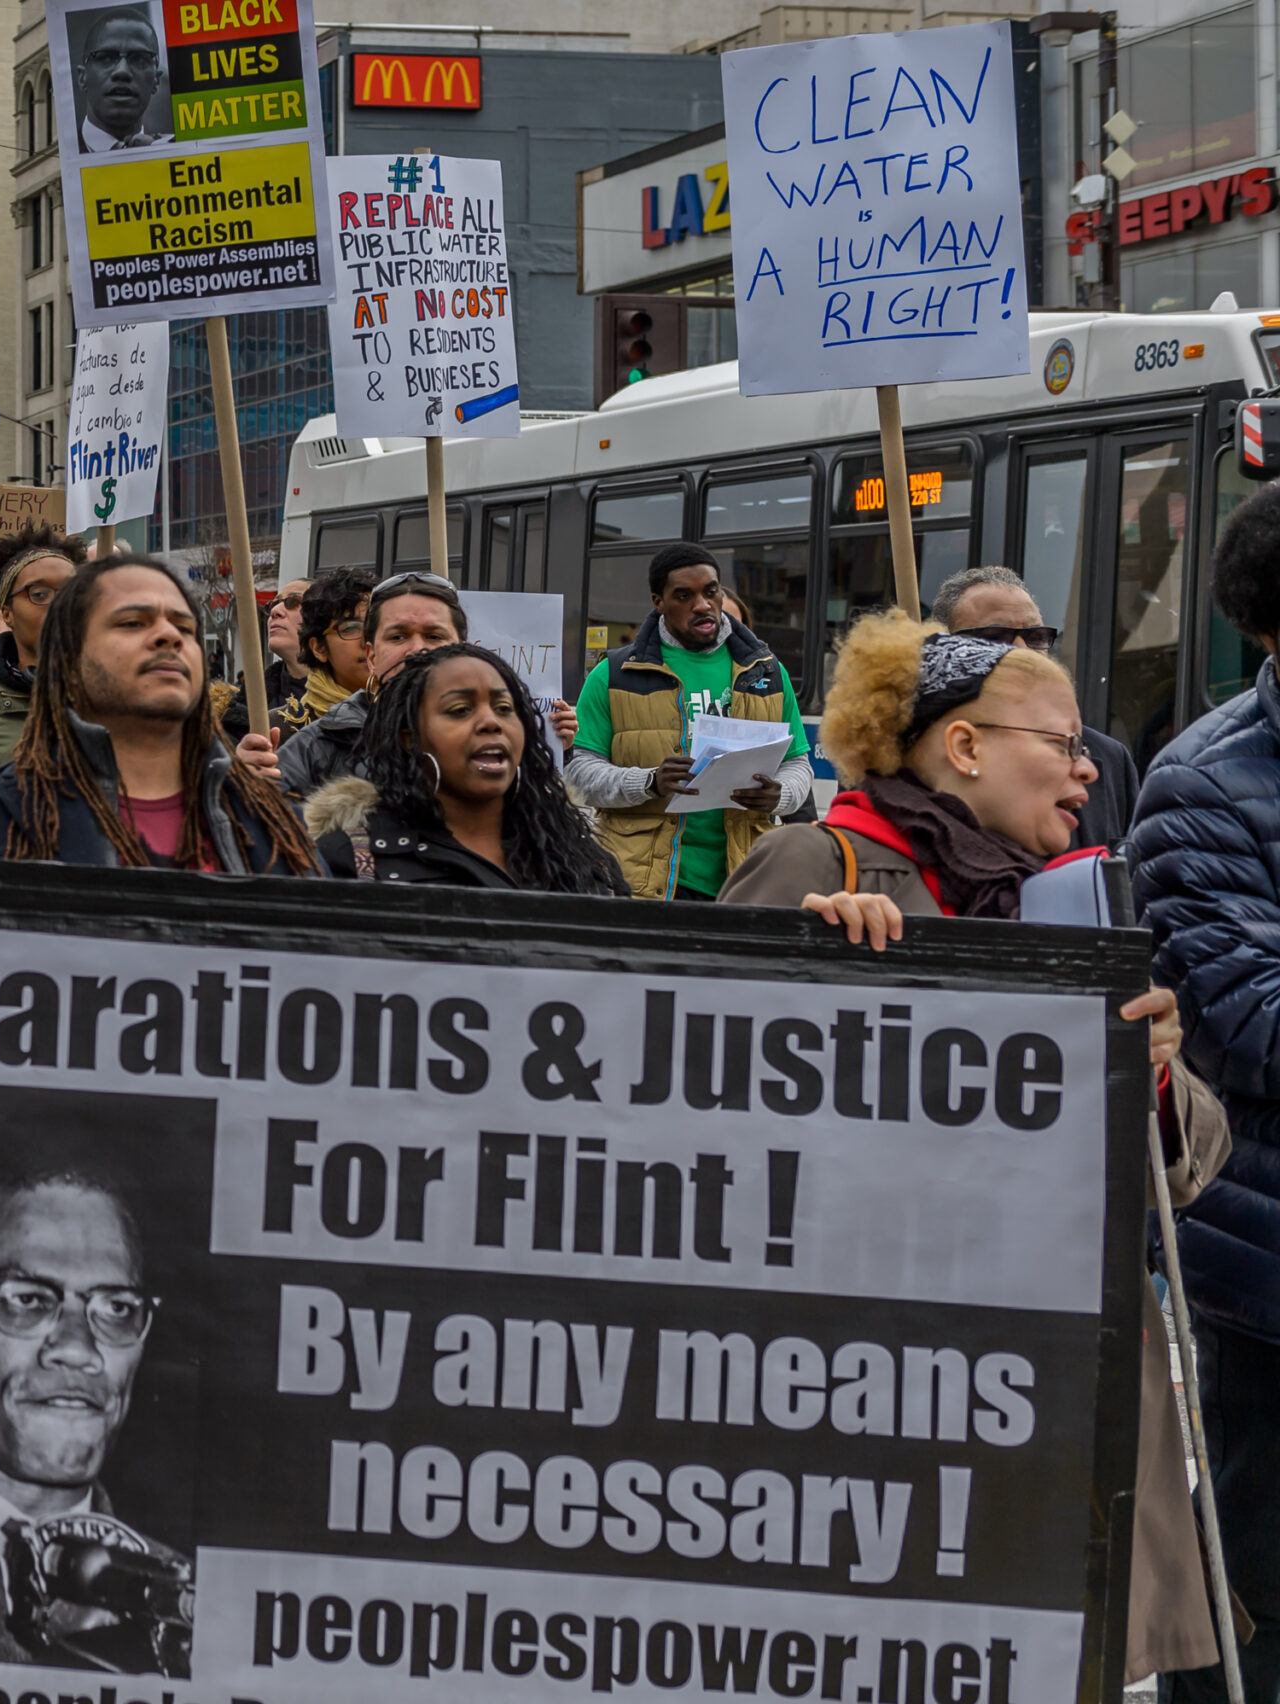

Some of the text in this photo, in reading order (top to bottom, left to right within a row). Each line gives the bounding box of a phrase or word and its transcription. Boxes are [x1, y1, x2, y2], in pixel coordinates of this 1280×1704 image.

[180, 0, 283, 34] BLACK
[191, 44, 279, 81] LIVES
[178, 90, 302, 131] MATTER
[754, 46, 992, 154] CLEAN
[169, 157, 222, 188] End
[767, 144, 973, 209] WATER
[96, 177, 302, 225] Environmental
[339, 191, 501, 233] REPLACE ALL
[642, 161, 730, 250] LAZ
[149, 218, 254, 250] Racism
[339, 229, 501, 260] PUBLIC WATER
[93, 240, 315, 278] Peoples Power Assemblies
[347, 258, 508, 295] INFRASTRUCTURE
[747, 215, 1004, 301] A HUMAN
[106, 259, 308, 304] peoplespower.net
[354, 292, 389, 328] AT
[414, 288, 446, 322] NO
[821, 267, 1016, 339] RIGHT!
[130, 341, 146, 364] de
[352, 327, 496, 365] TO RESIDENTS
[1133, 338, 1180, 372] 8363
[109, 372, 145, 396] desde
[366, 371, 385, 401] &
[87, 407, 132, 432] cambio
[70, 431, 158, 485] Flint River
[855, 477, 885, 511] M100
[911, 488, 942, 505] 220 ST
[521, 999, 604, 1102] &
[629, 990, 1065, 1134] Justice
[262, 1118, 445, 1244] For
[472, 1129, 736, 1268] Flint
[276, 1284, 1035, 1447] By any means
[327, 1437, 912, 1584] necessary
[253, 1587, 1018, 1704] peoplespower.net
